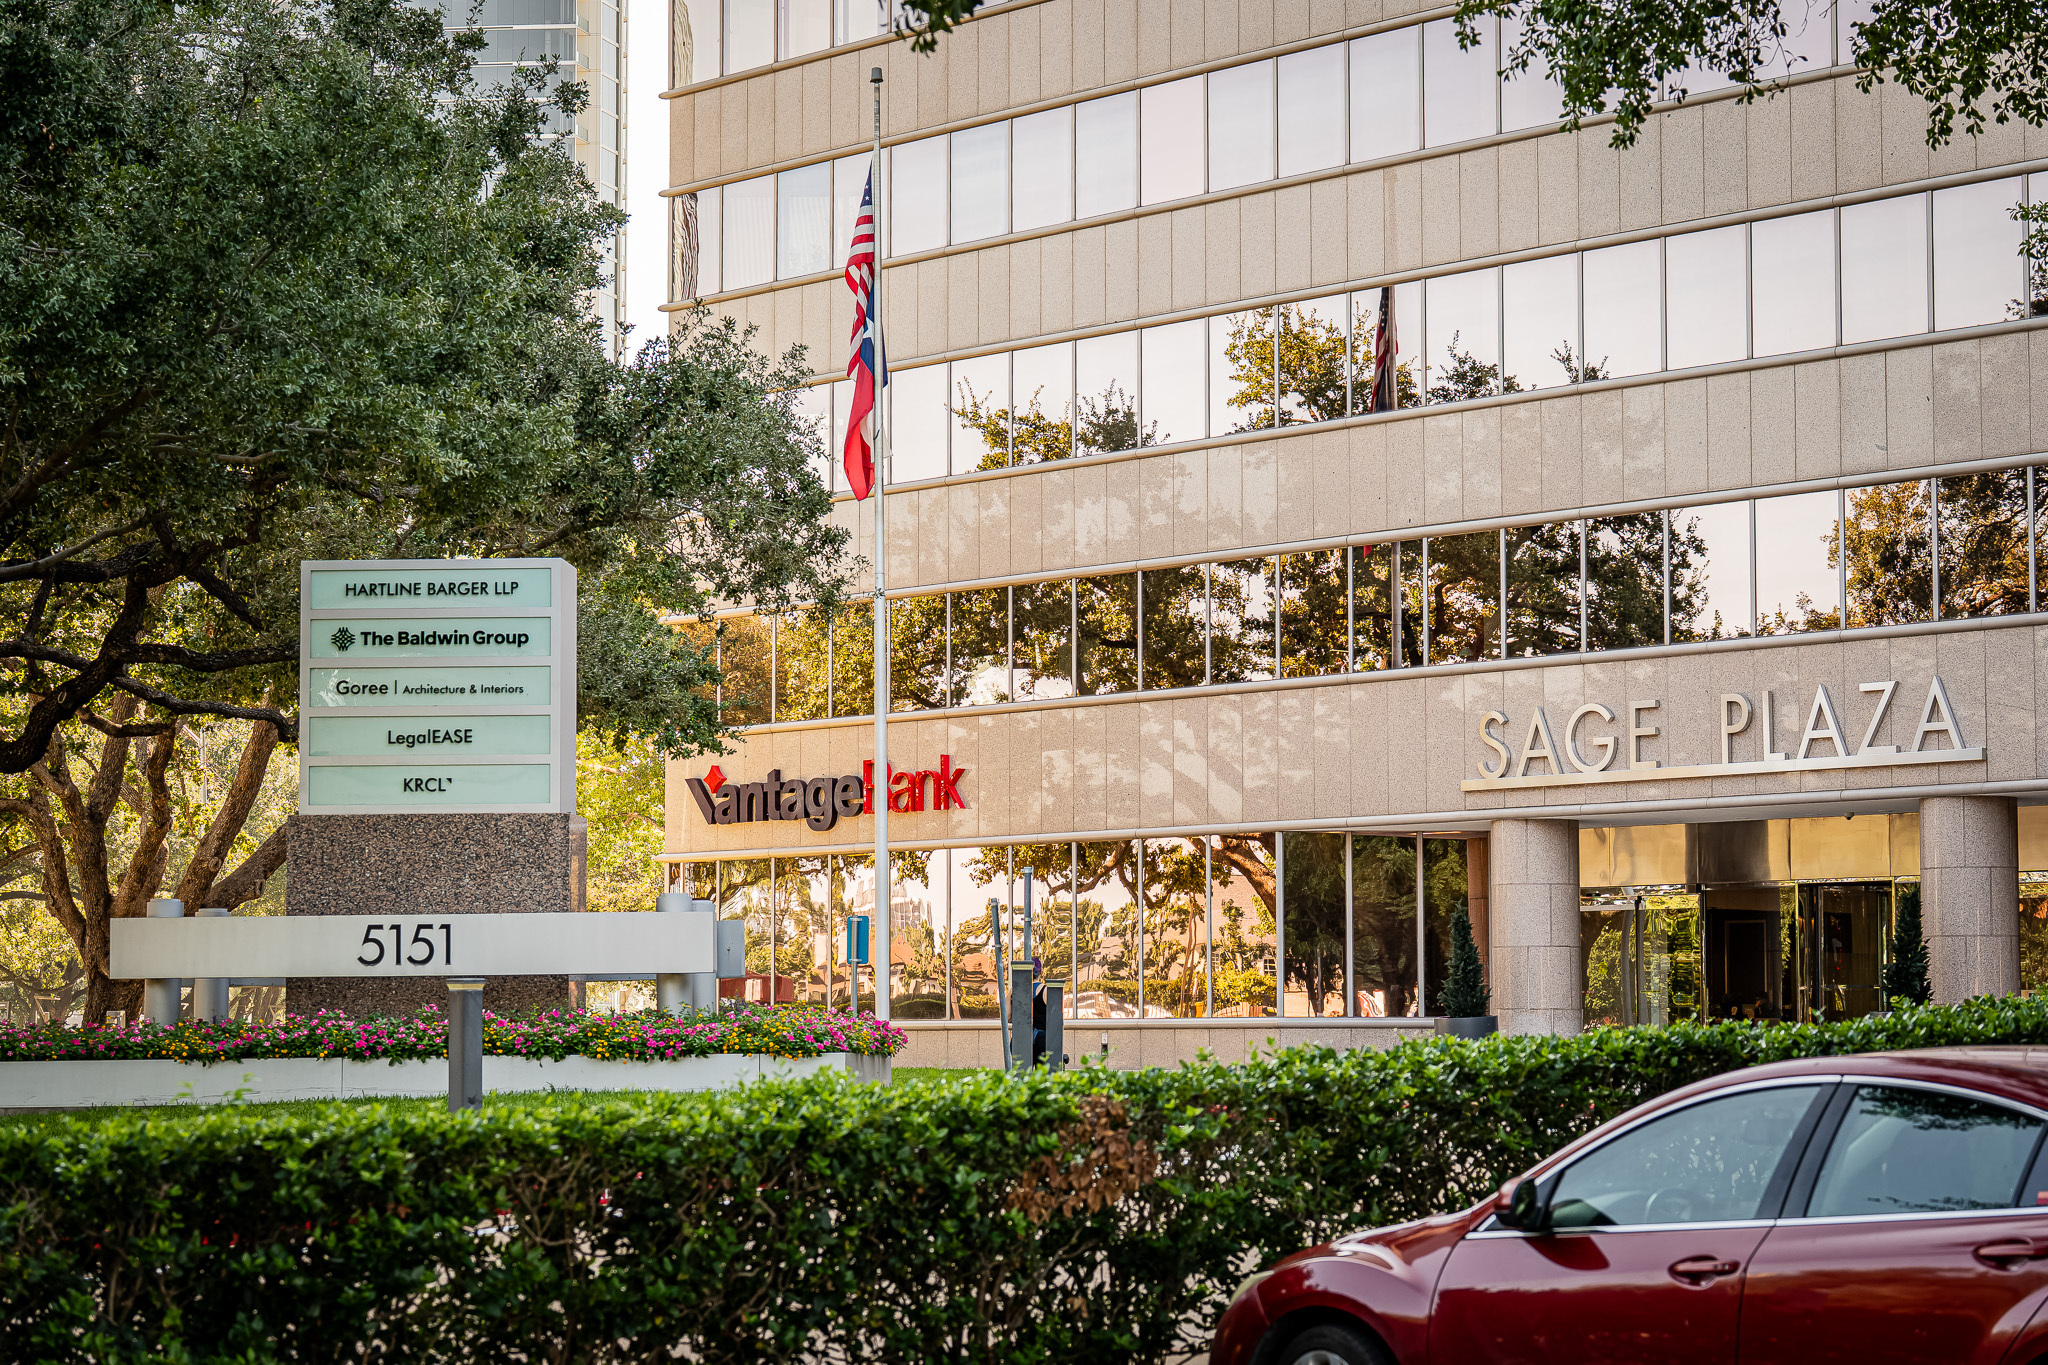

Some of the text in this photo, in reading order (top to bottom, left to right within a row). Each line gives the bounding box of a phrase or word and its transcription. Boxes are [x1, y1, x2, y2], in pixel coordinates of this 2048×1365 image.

[345, 581, 520, 597] HARTLINE BARGER LLP
[361, 629, 530, 648] The Baldwin Group
[336, 680, 524, 695] Goree Architecture & Interiors
[1477, 675, 1967, 780] SAGE PLAZA
[387, 729, 473, 748] LegalEASE
[403, 777, 447, 792] KRCL
[357, 923, 452, 967] 5151
